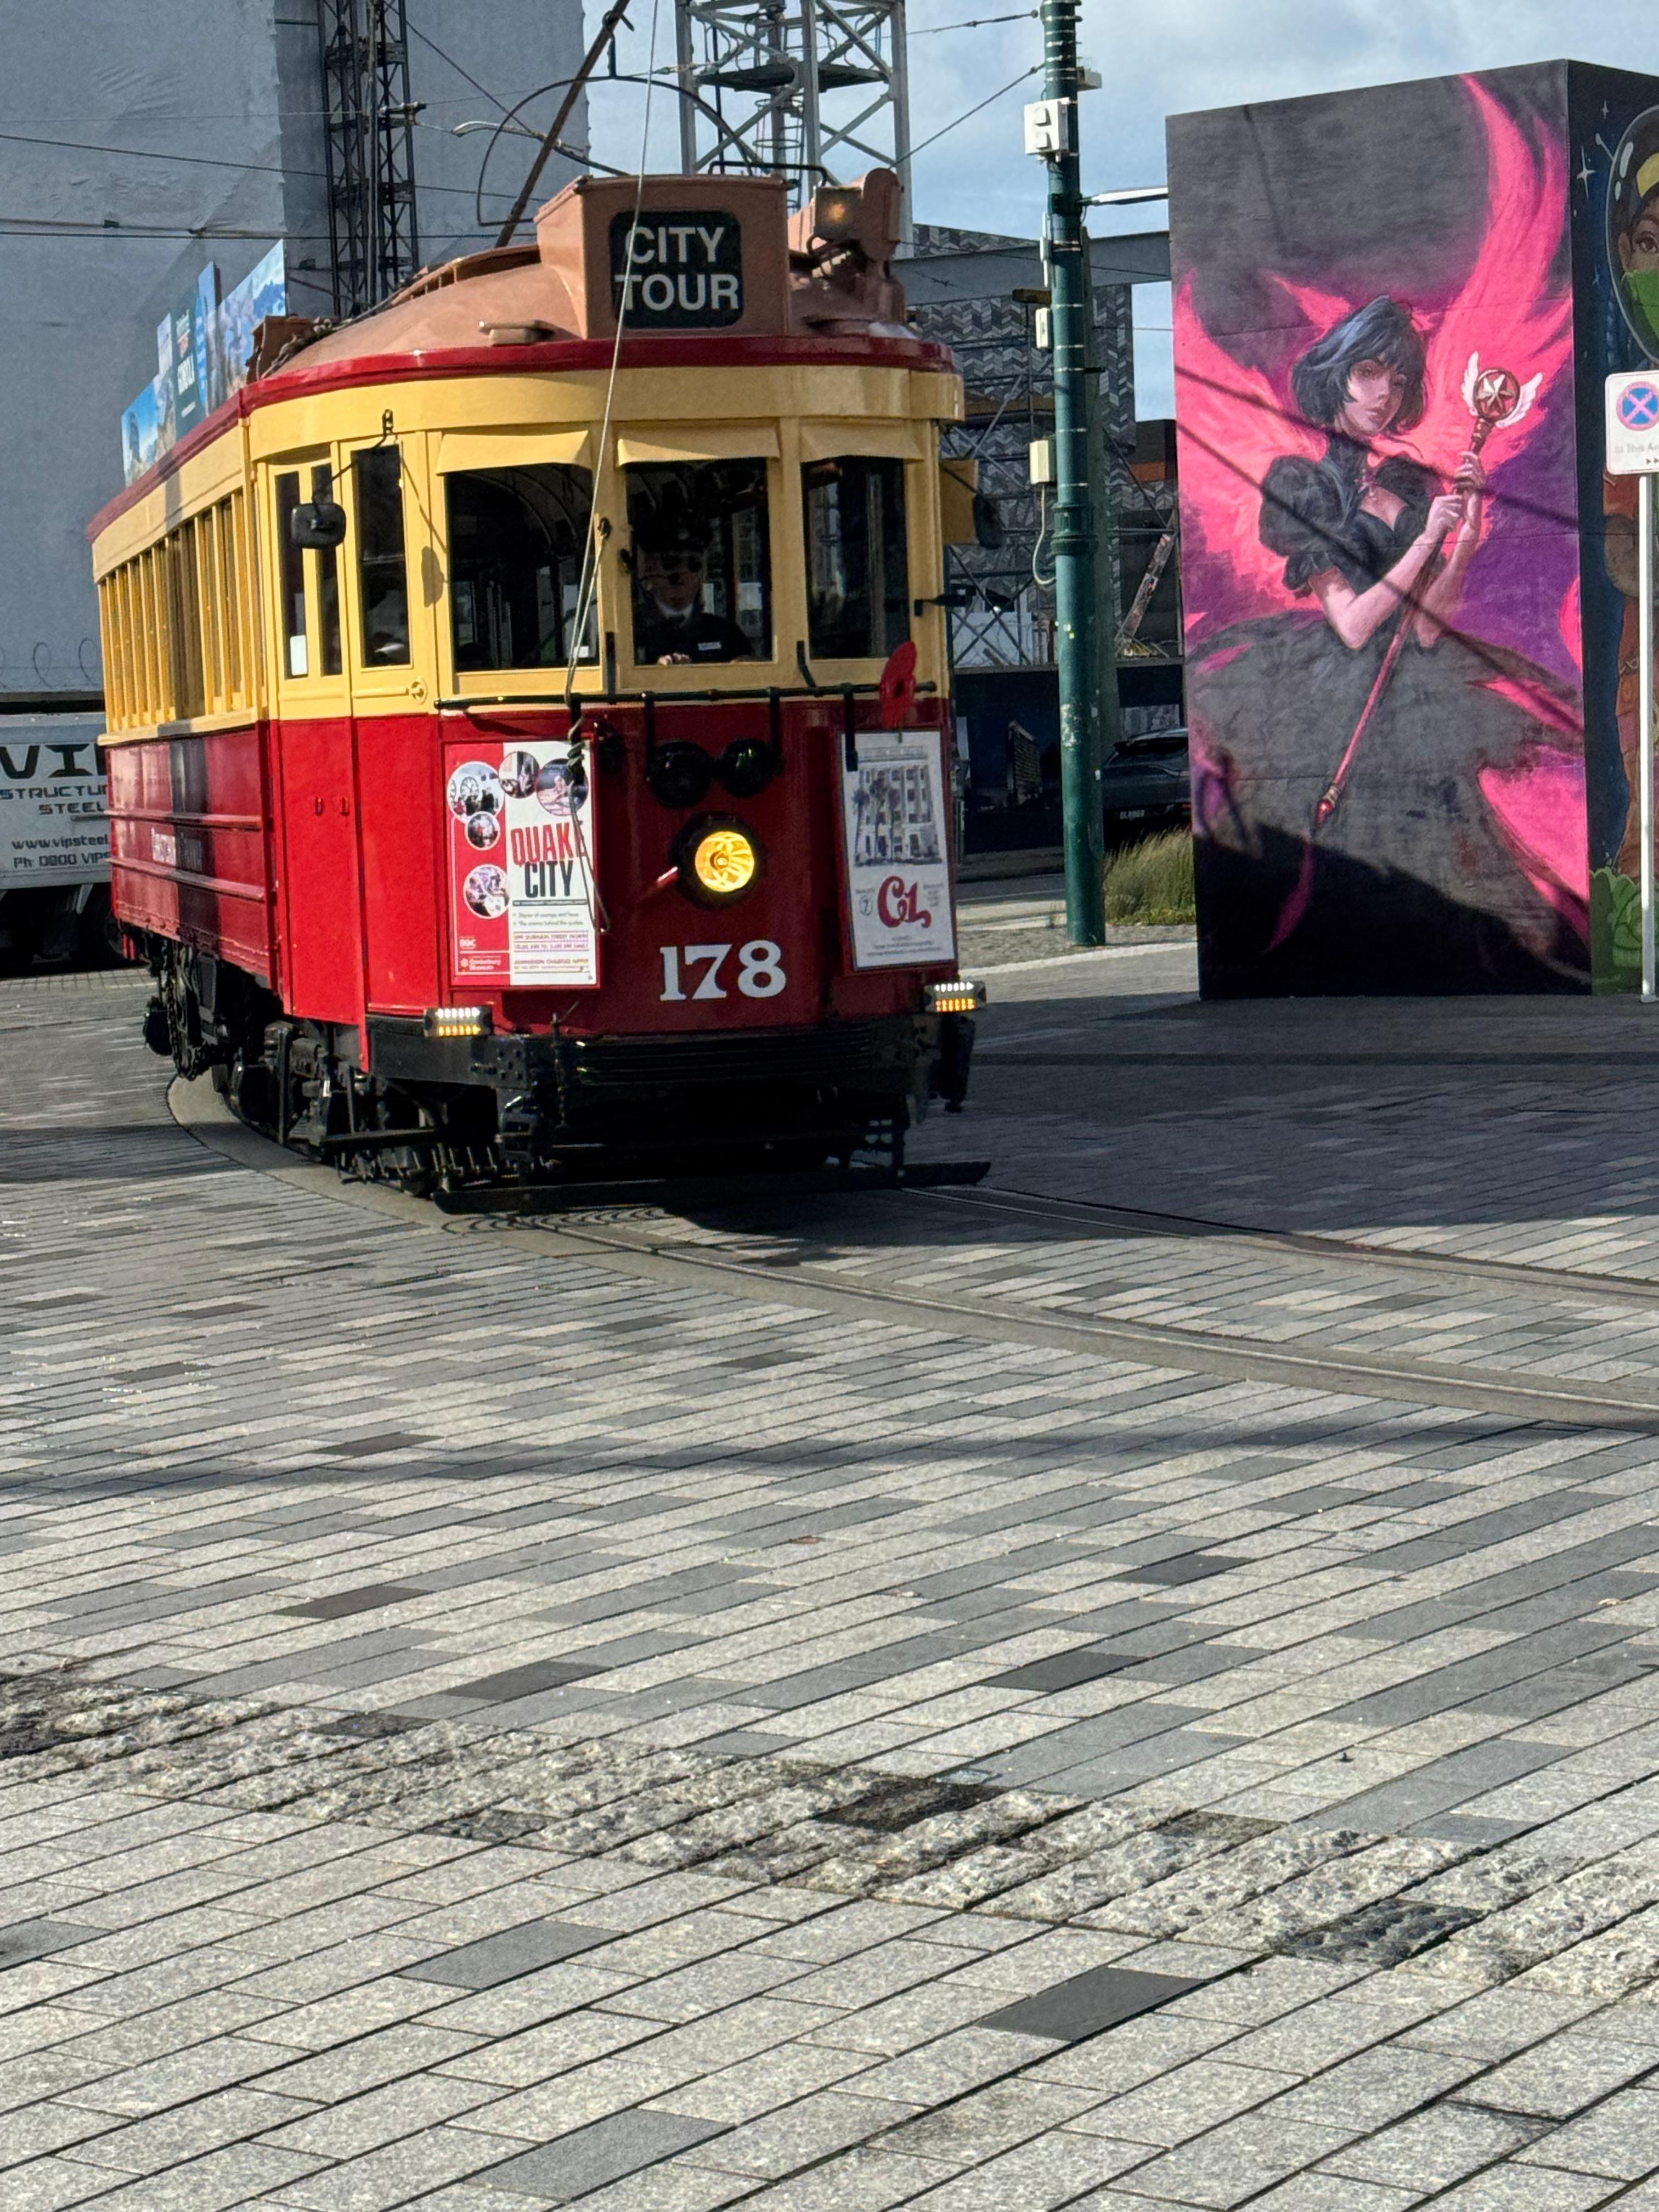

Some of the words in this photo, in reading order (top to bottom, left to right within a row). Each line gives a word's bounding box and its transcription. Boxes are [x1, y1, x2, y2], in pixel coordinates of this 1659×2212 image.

[625, 226, 724, 264] CITY
[614, 274, 740, 312] TOUR
[0, 743, 108, 780] VI
[0, 784, 107, 800] STRUCTU
[38, 801, 106, 816] STEEL
[38, 854, 77, 867] 0800
[524, 860, 573, 898] CITY
[659, 940, 786, 1001] 178
